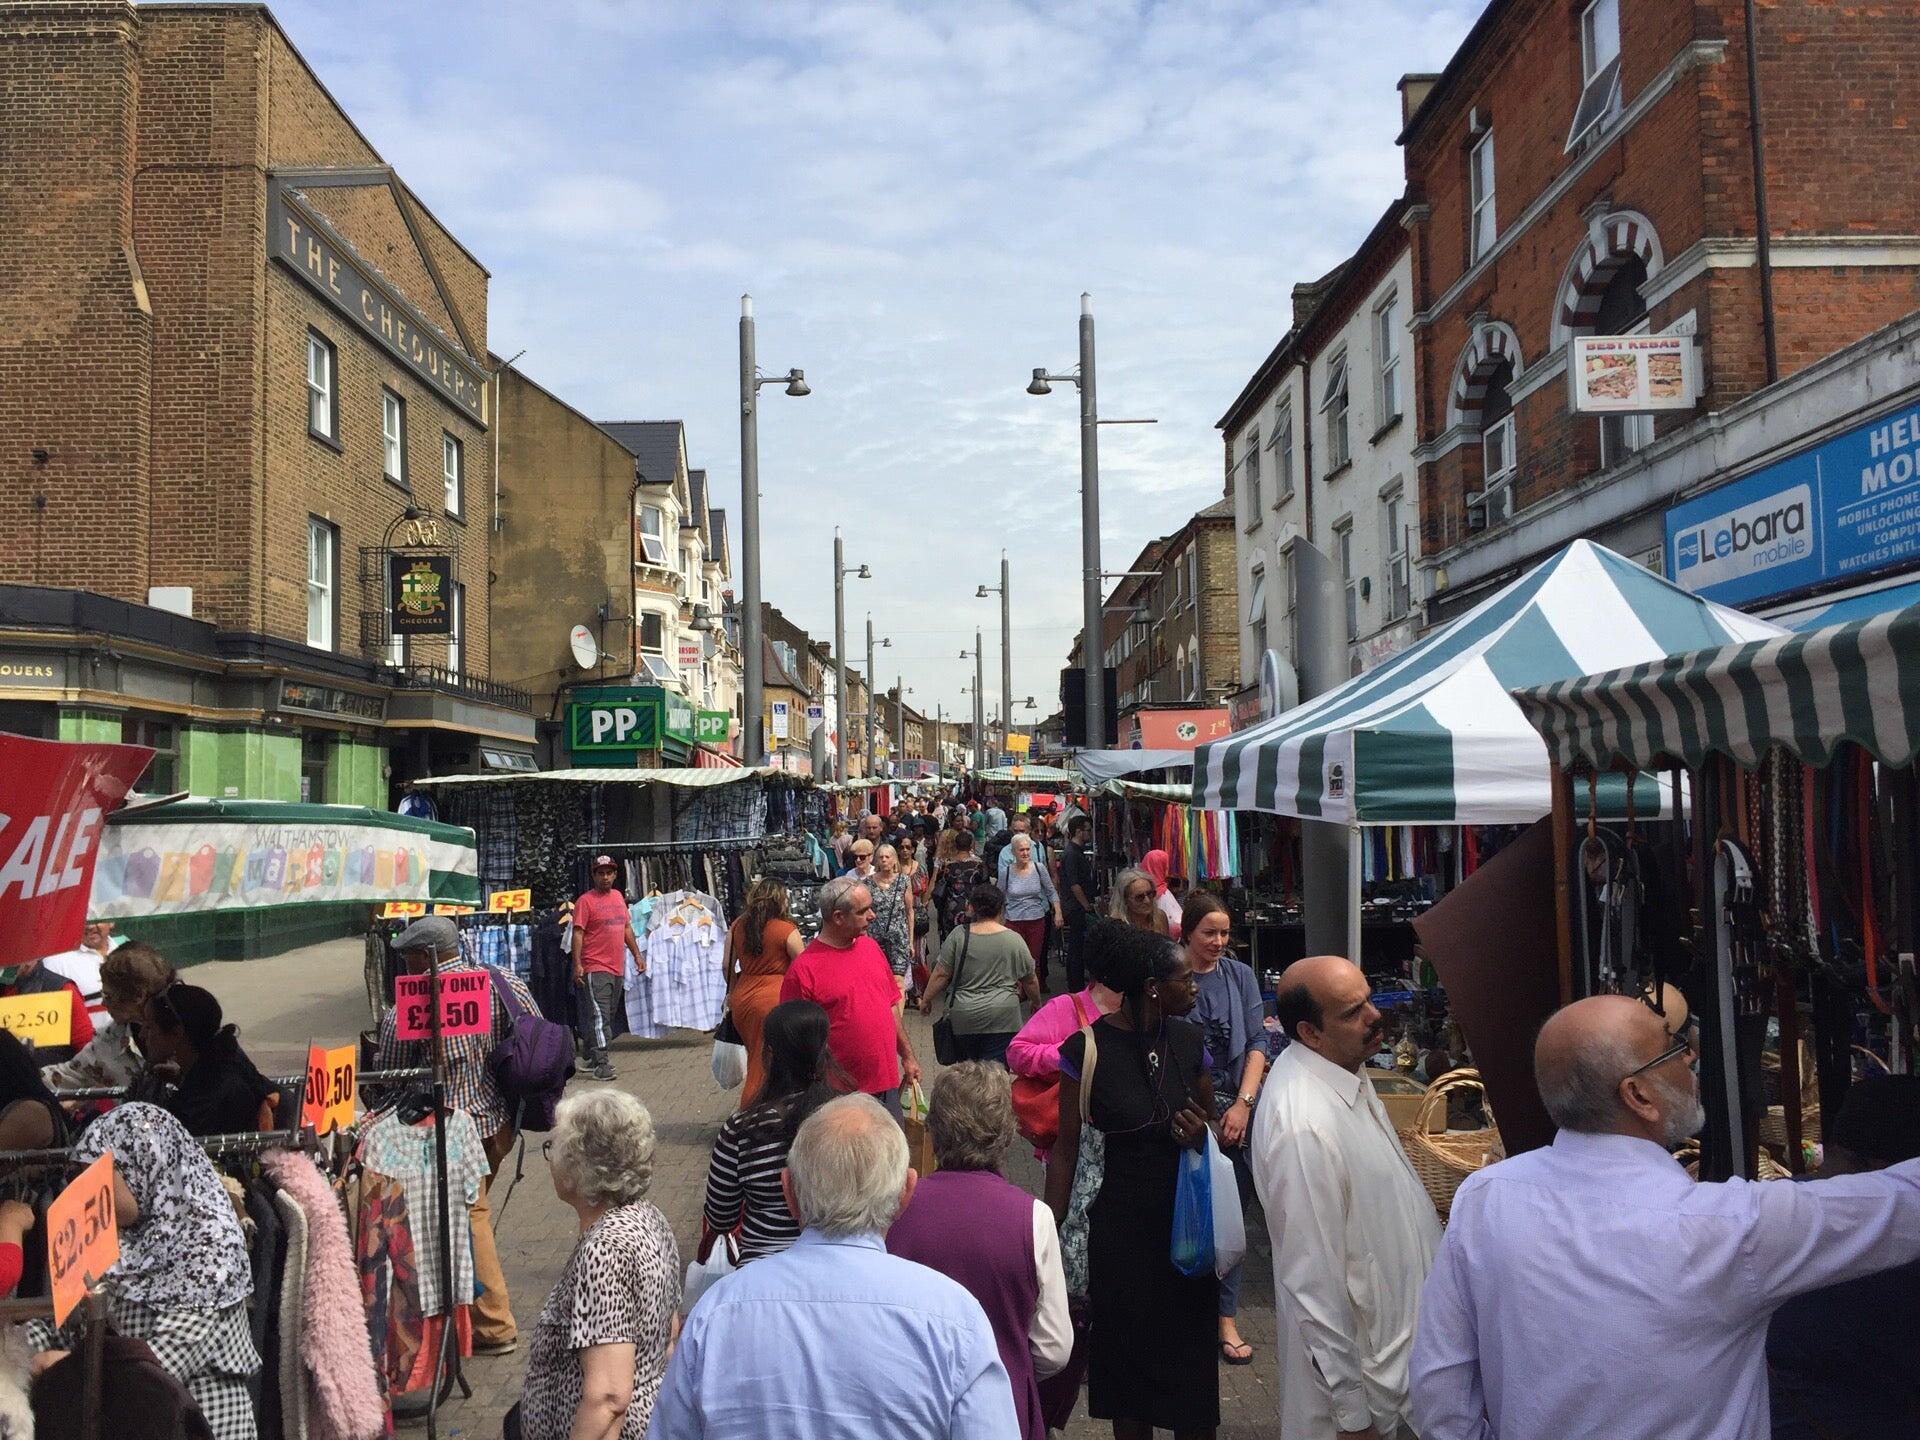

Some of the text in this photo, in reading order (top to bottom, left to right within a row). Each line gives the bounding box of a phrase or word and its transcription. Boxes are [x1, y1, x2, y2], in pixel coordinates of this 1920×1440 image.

[287, 217, 477, 408] THE CHEQUERS
[1838, 505, 1878, 528] MOBILE
[1701, 502, 1805, 563] Lebara
[1753, 536, 1805, 567] mobile
[1838, 547, 1889, 571] WATCHES
[255, 827, 351, 849] WALTHAMSTOW
[0, 807, 102, 899] ALE
[495, 893, 526, 909] £5
[450, 976, 486, 992] ONLY
[53, 1184, 112, 1287] £2.50
